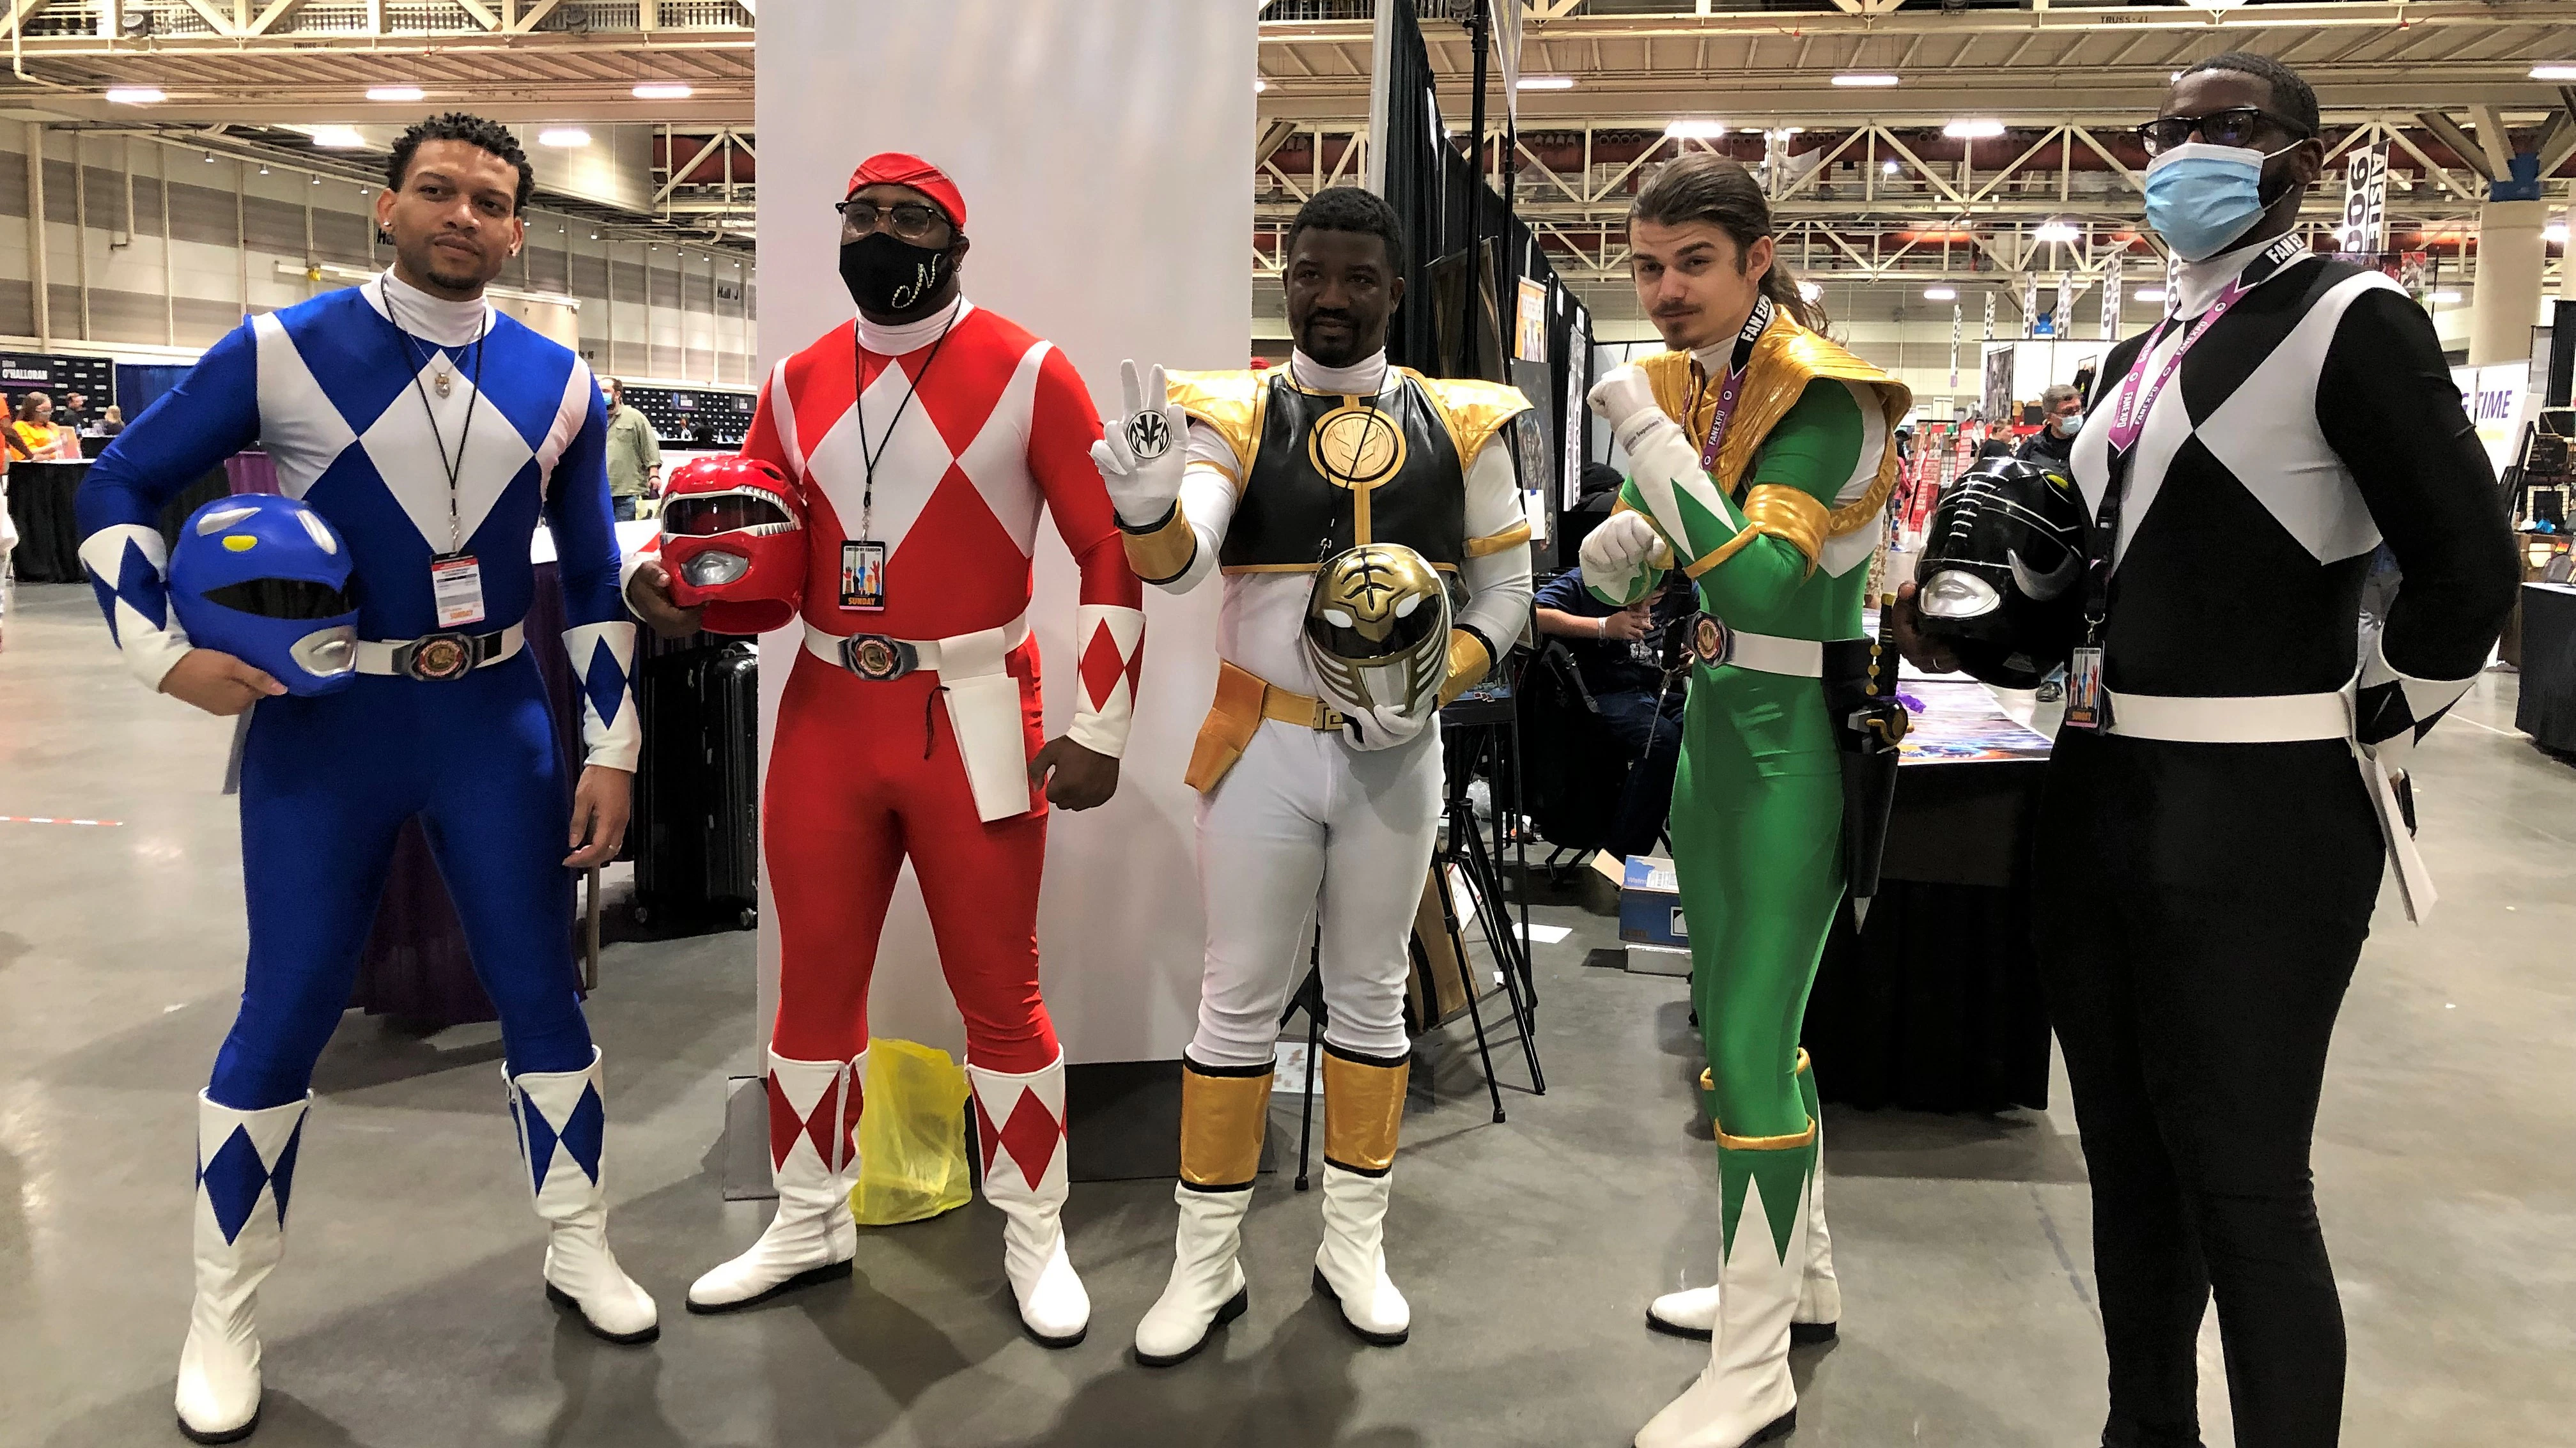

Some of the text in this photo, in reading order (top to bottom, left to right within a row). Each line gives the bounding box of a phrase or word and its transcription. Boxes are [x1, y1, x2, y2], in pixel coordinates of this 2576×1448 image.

[2345, 157, 2369, 252] 900
[2366, 153, 2385, 241] AISLE
[2265, 238, 2297, 264] FAN
[2168, 258, 2180, 310] 00
[1741, 315, 1764, 342] FAN
[2176, 321, 2208, 356] FANEXPO
[2116, 391, 2134, 428] FANEXPO
[2478, 390, 2513, 419] TIME
[1708, 410, 1725, 446] FANEXPO
[848, 597, 876, 606] SUNDAY
